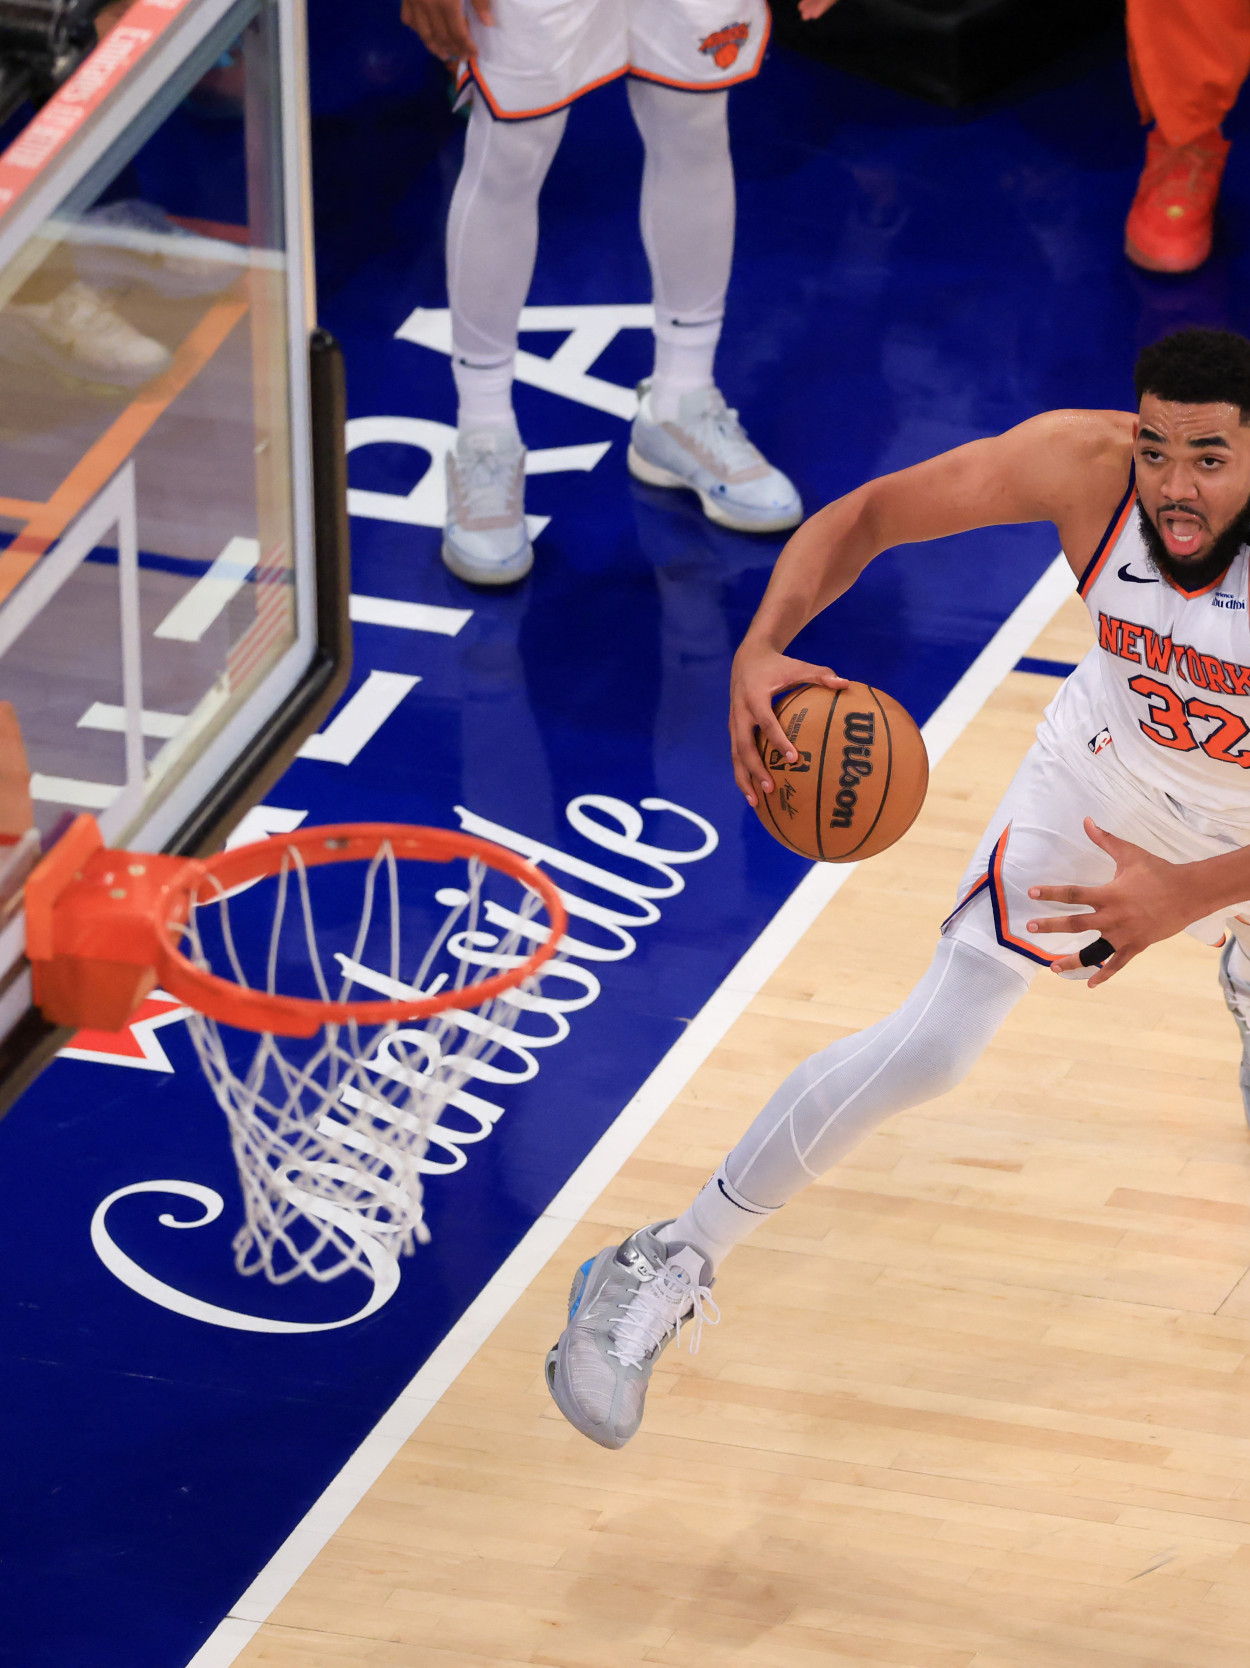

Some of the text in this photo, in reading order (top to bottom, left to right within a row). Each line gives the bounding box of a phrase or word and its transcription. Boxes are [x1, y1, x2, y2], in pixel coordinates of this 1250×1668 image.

[1099, 610, 1173, 675] NEW
[830, 711, 875, 828] Wilson
[91, 794, 719, 1334] Courtside
